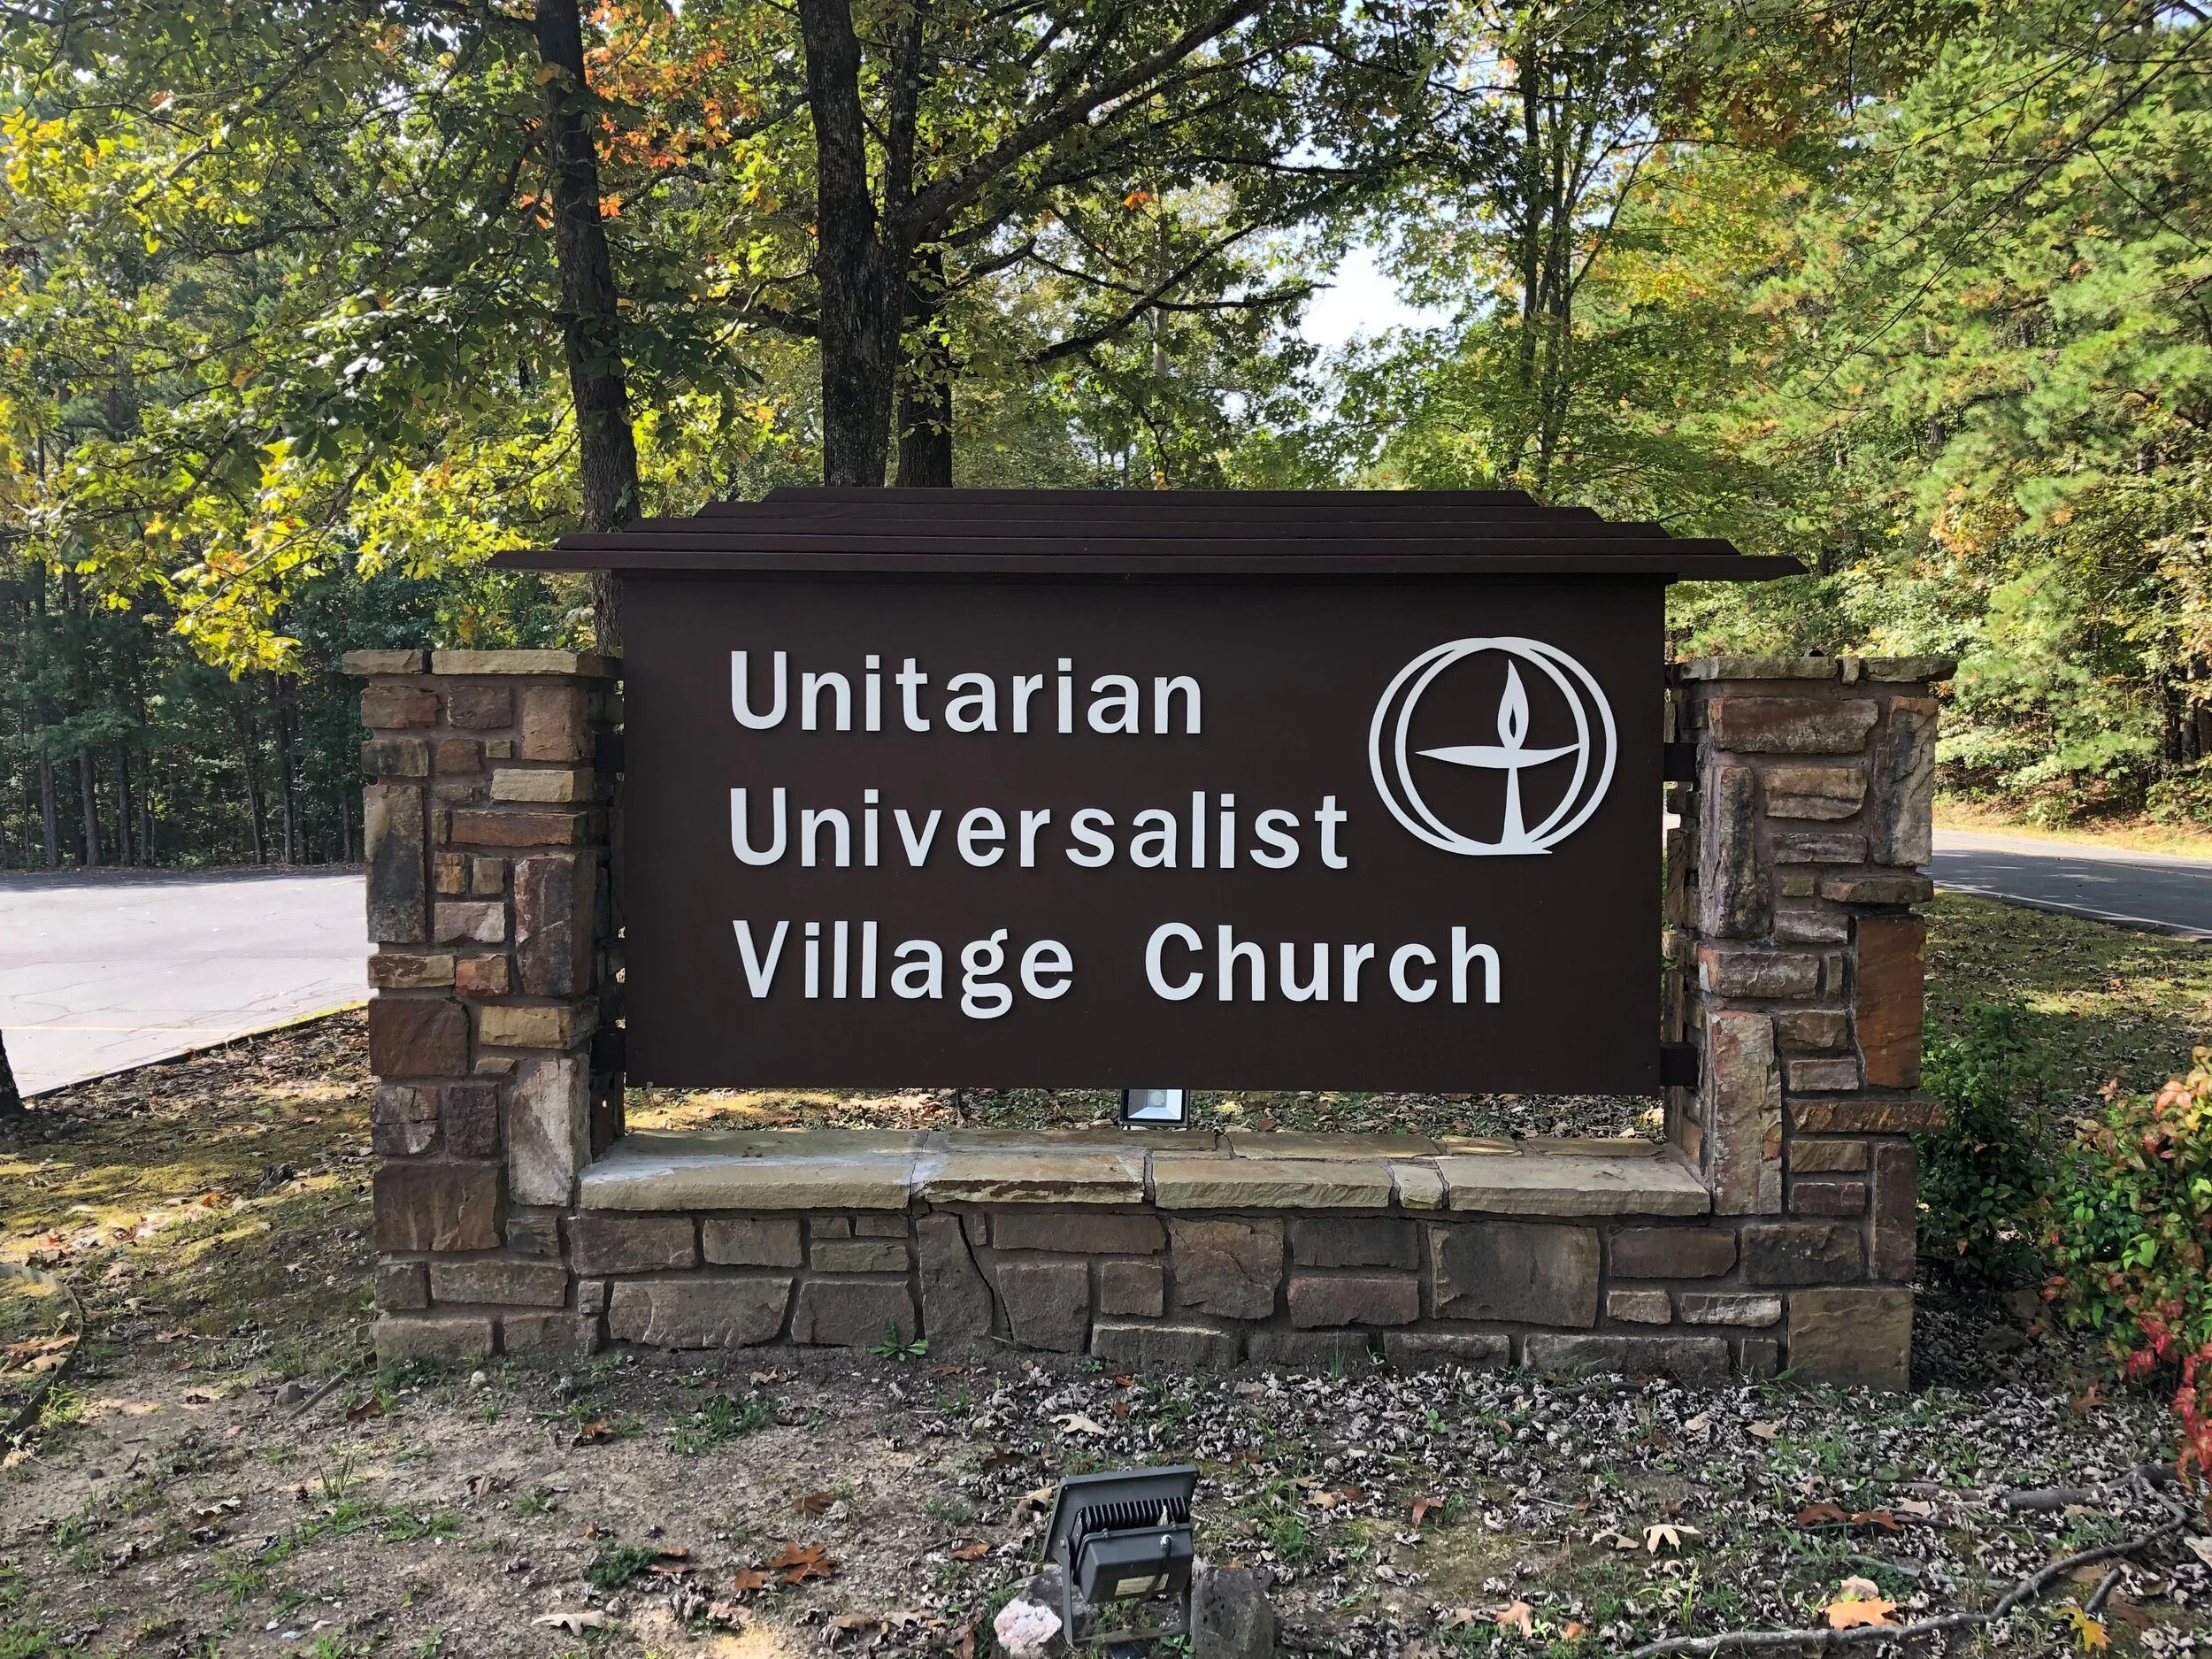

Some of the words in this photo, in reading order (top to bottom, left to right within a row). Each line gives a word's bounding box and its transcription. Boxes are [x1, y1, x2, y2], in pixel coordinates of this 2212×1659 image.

[731, 650, 1201, 734] Unitarian
[730, 787, 1348, 870] Universalist
[732, 919, 1073, 1019] Village
[1145, 923, 1501, 1003] Church
